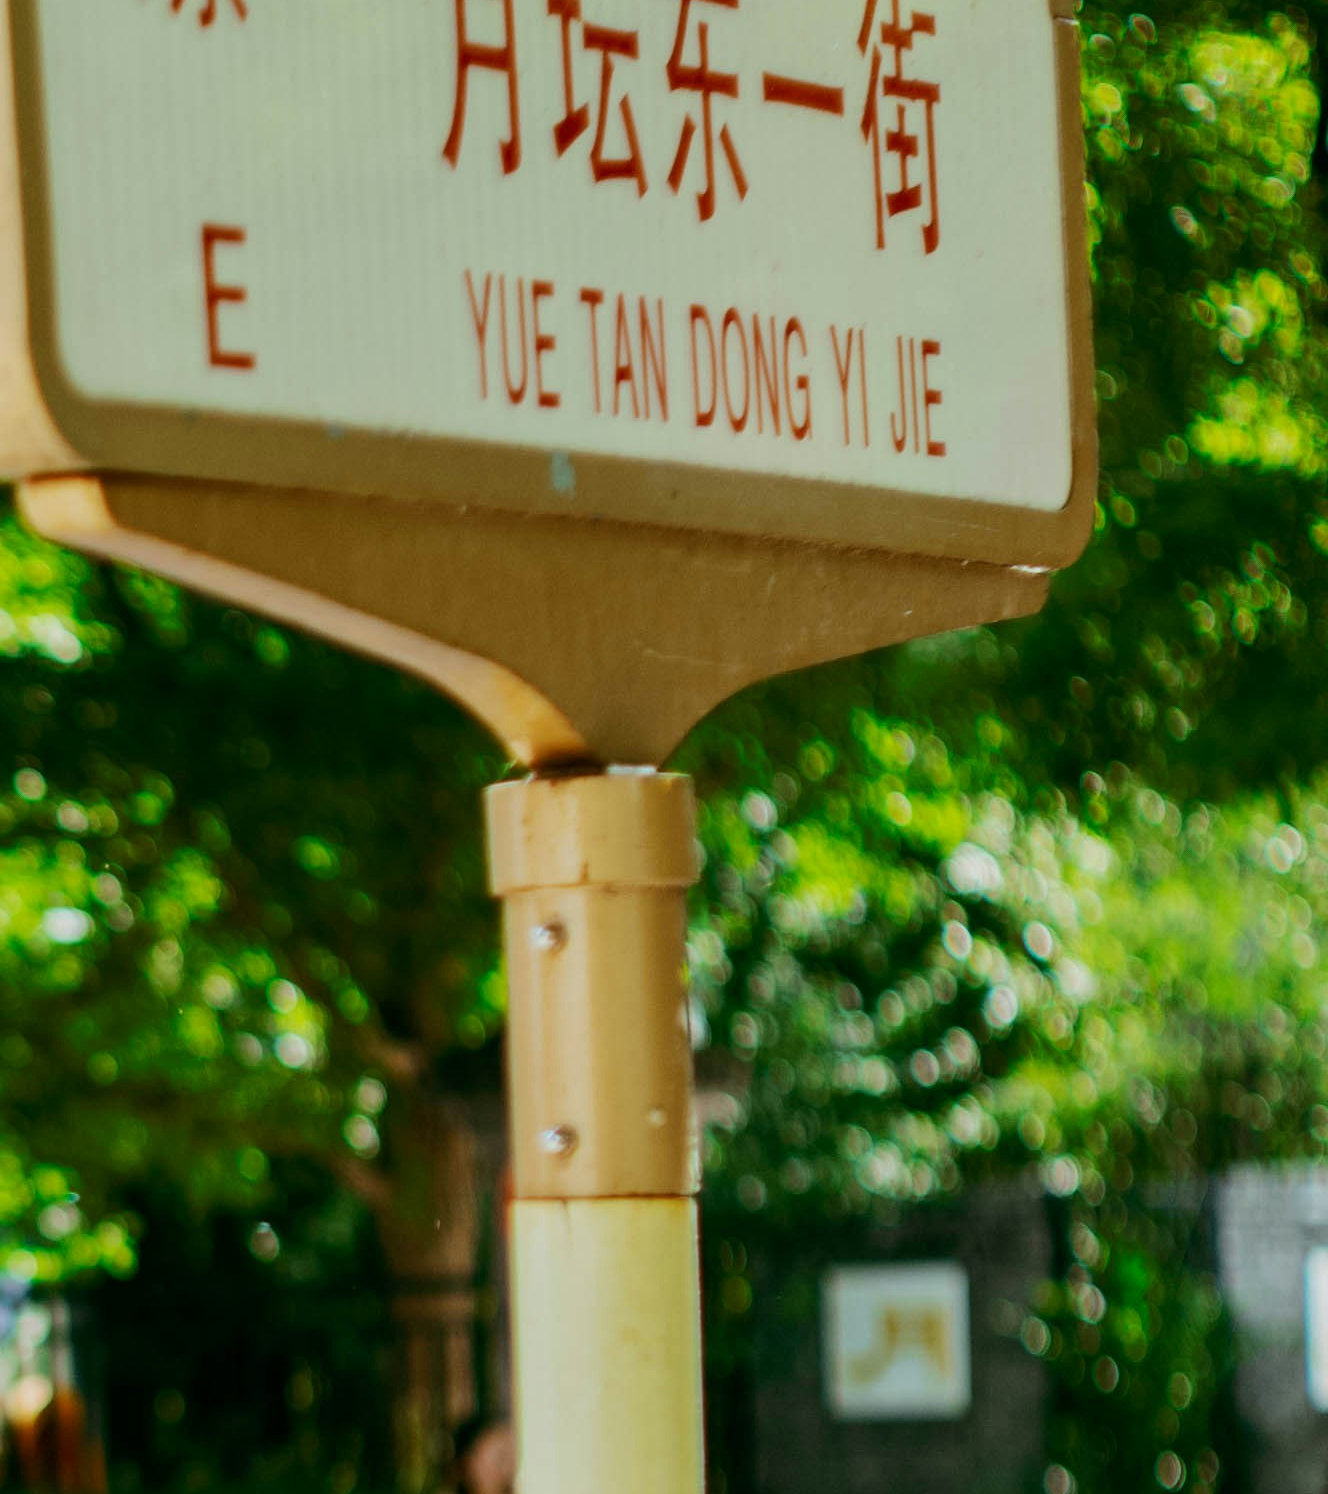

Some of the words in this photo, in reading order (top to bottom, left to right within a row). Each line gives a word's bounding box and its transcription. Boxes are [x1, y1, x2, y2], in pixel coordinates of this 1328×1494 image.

[200, 221, 257, 373] E
[463, 268, 562, 410] YUE
[578, 286, 670, 423] TAN
[688, 302, 814, 443] DONG
[828, 324, 871, 447] YI
[889, 335, 948, 459] JIE
